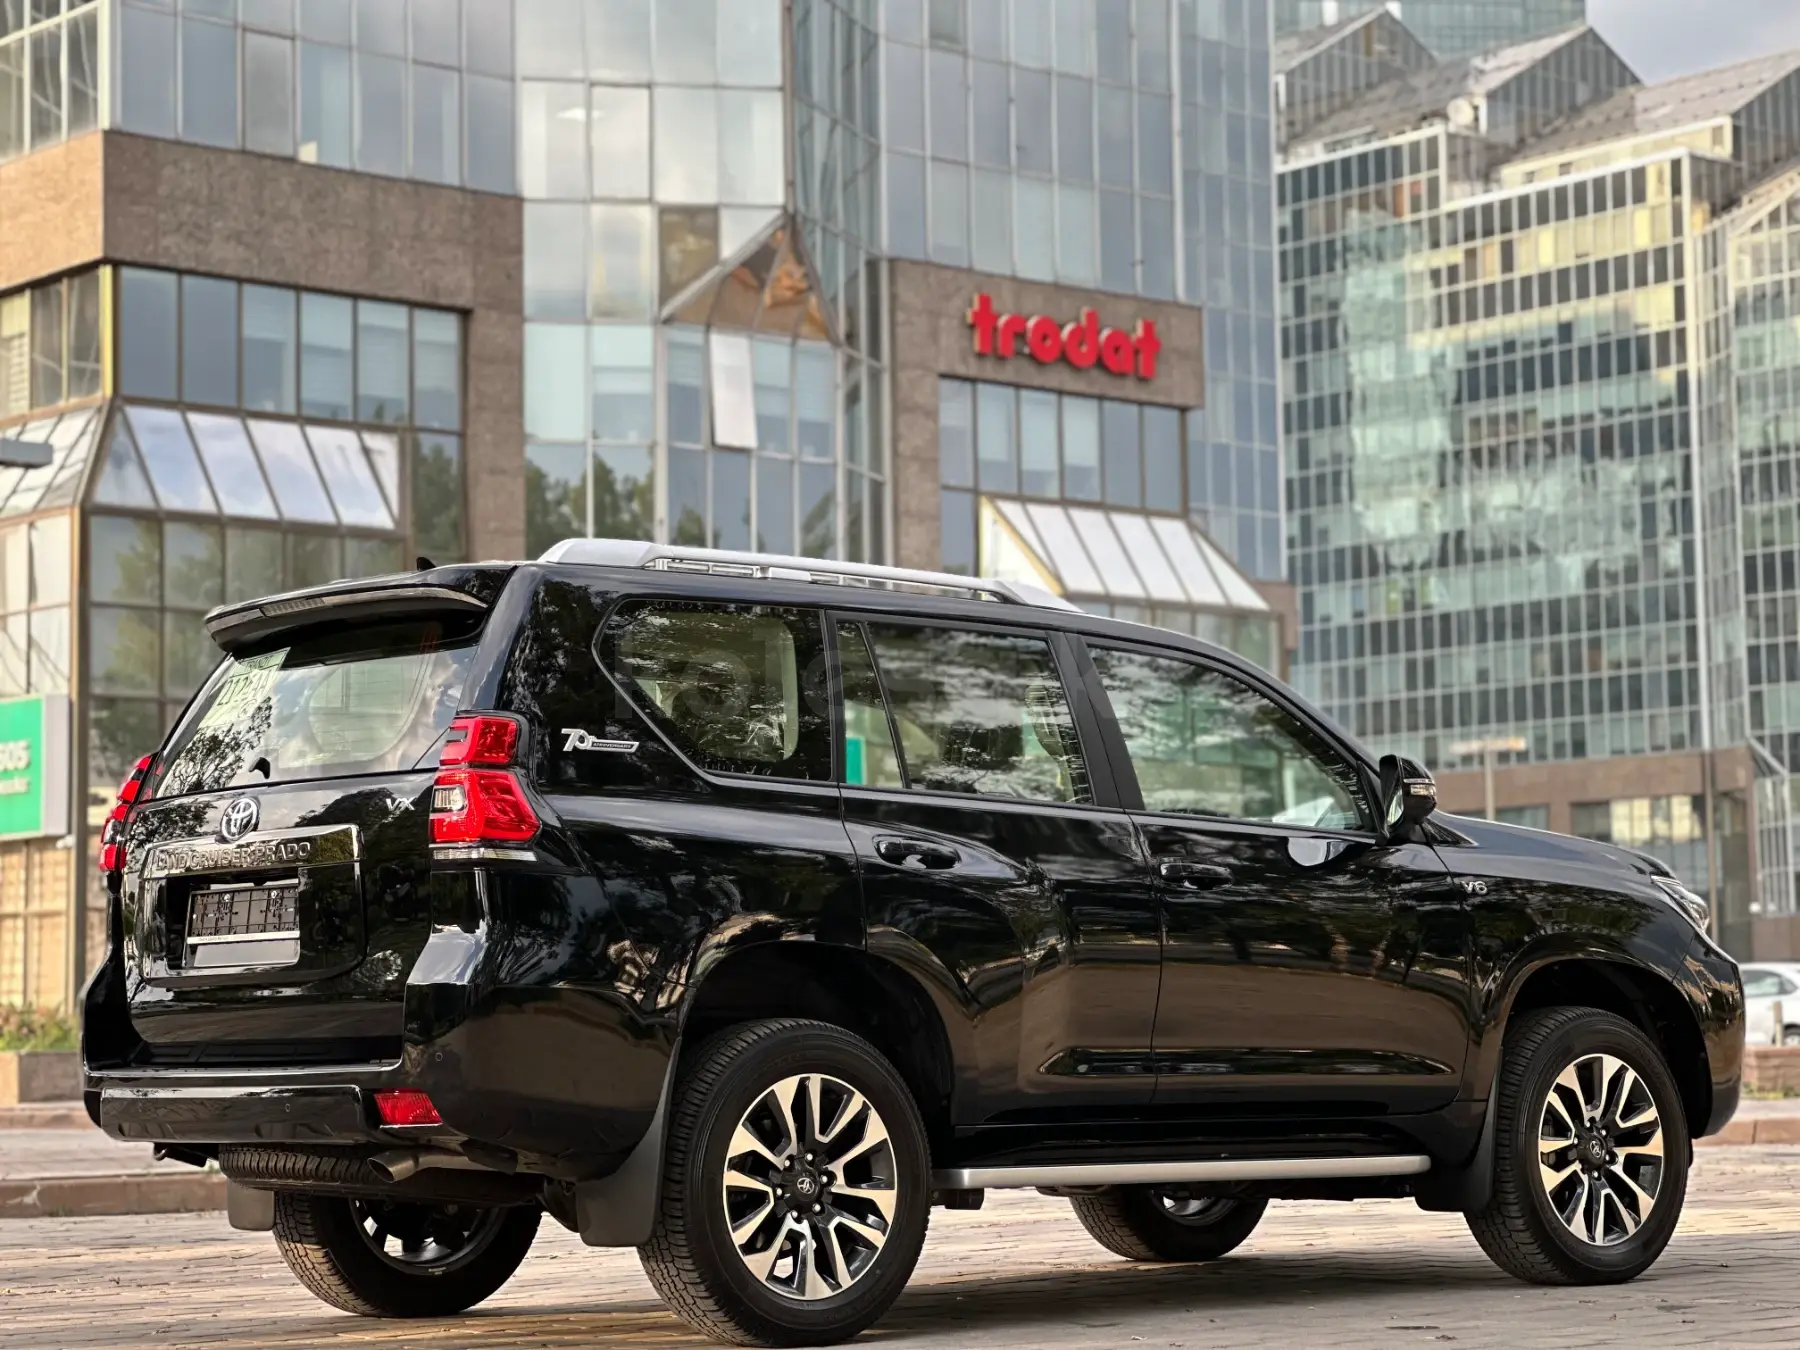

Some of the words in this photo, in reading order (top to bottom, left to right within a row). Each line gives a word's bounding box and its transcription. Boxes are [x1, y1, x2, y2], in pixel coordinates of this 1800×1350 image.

[965, 292, 1162, 381] trodat
[385, 796, 416, 812] VX
[155, 850, 188, 872] LAND
[188, 846, 251, 870] CRUISER
[254, 841, 311, 865] PRADO
[1460, 880, 1488, 896] V6
